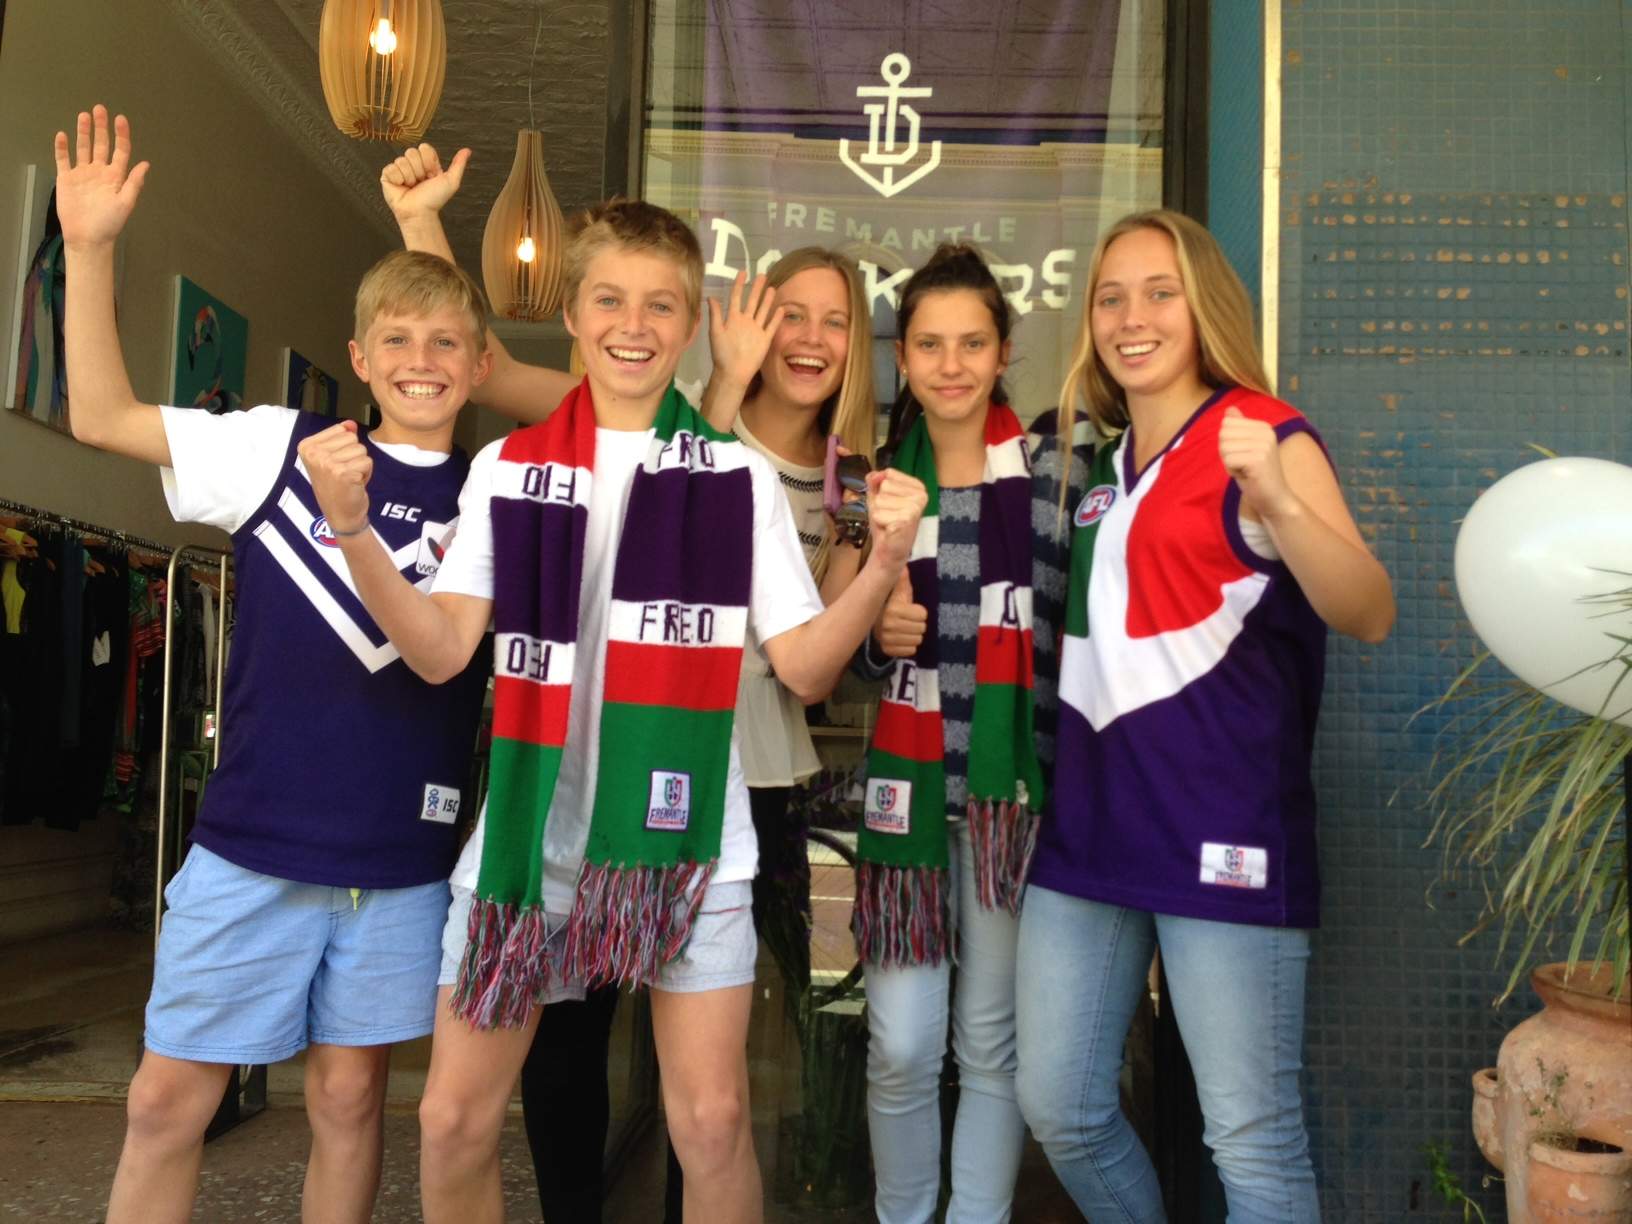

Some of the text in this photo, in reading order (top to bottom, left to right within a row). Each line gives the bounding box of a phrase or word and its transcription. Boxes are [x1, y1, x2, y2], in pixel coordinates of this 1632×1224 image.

[768, 202, 1016, 250] FREMANTLE
[705, 217, 1076, 316] DKRS
[380, 502, 422, 523] ISC
[640, 604, 714, 644] FREO
[443, 798, 459, 813] ISC
